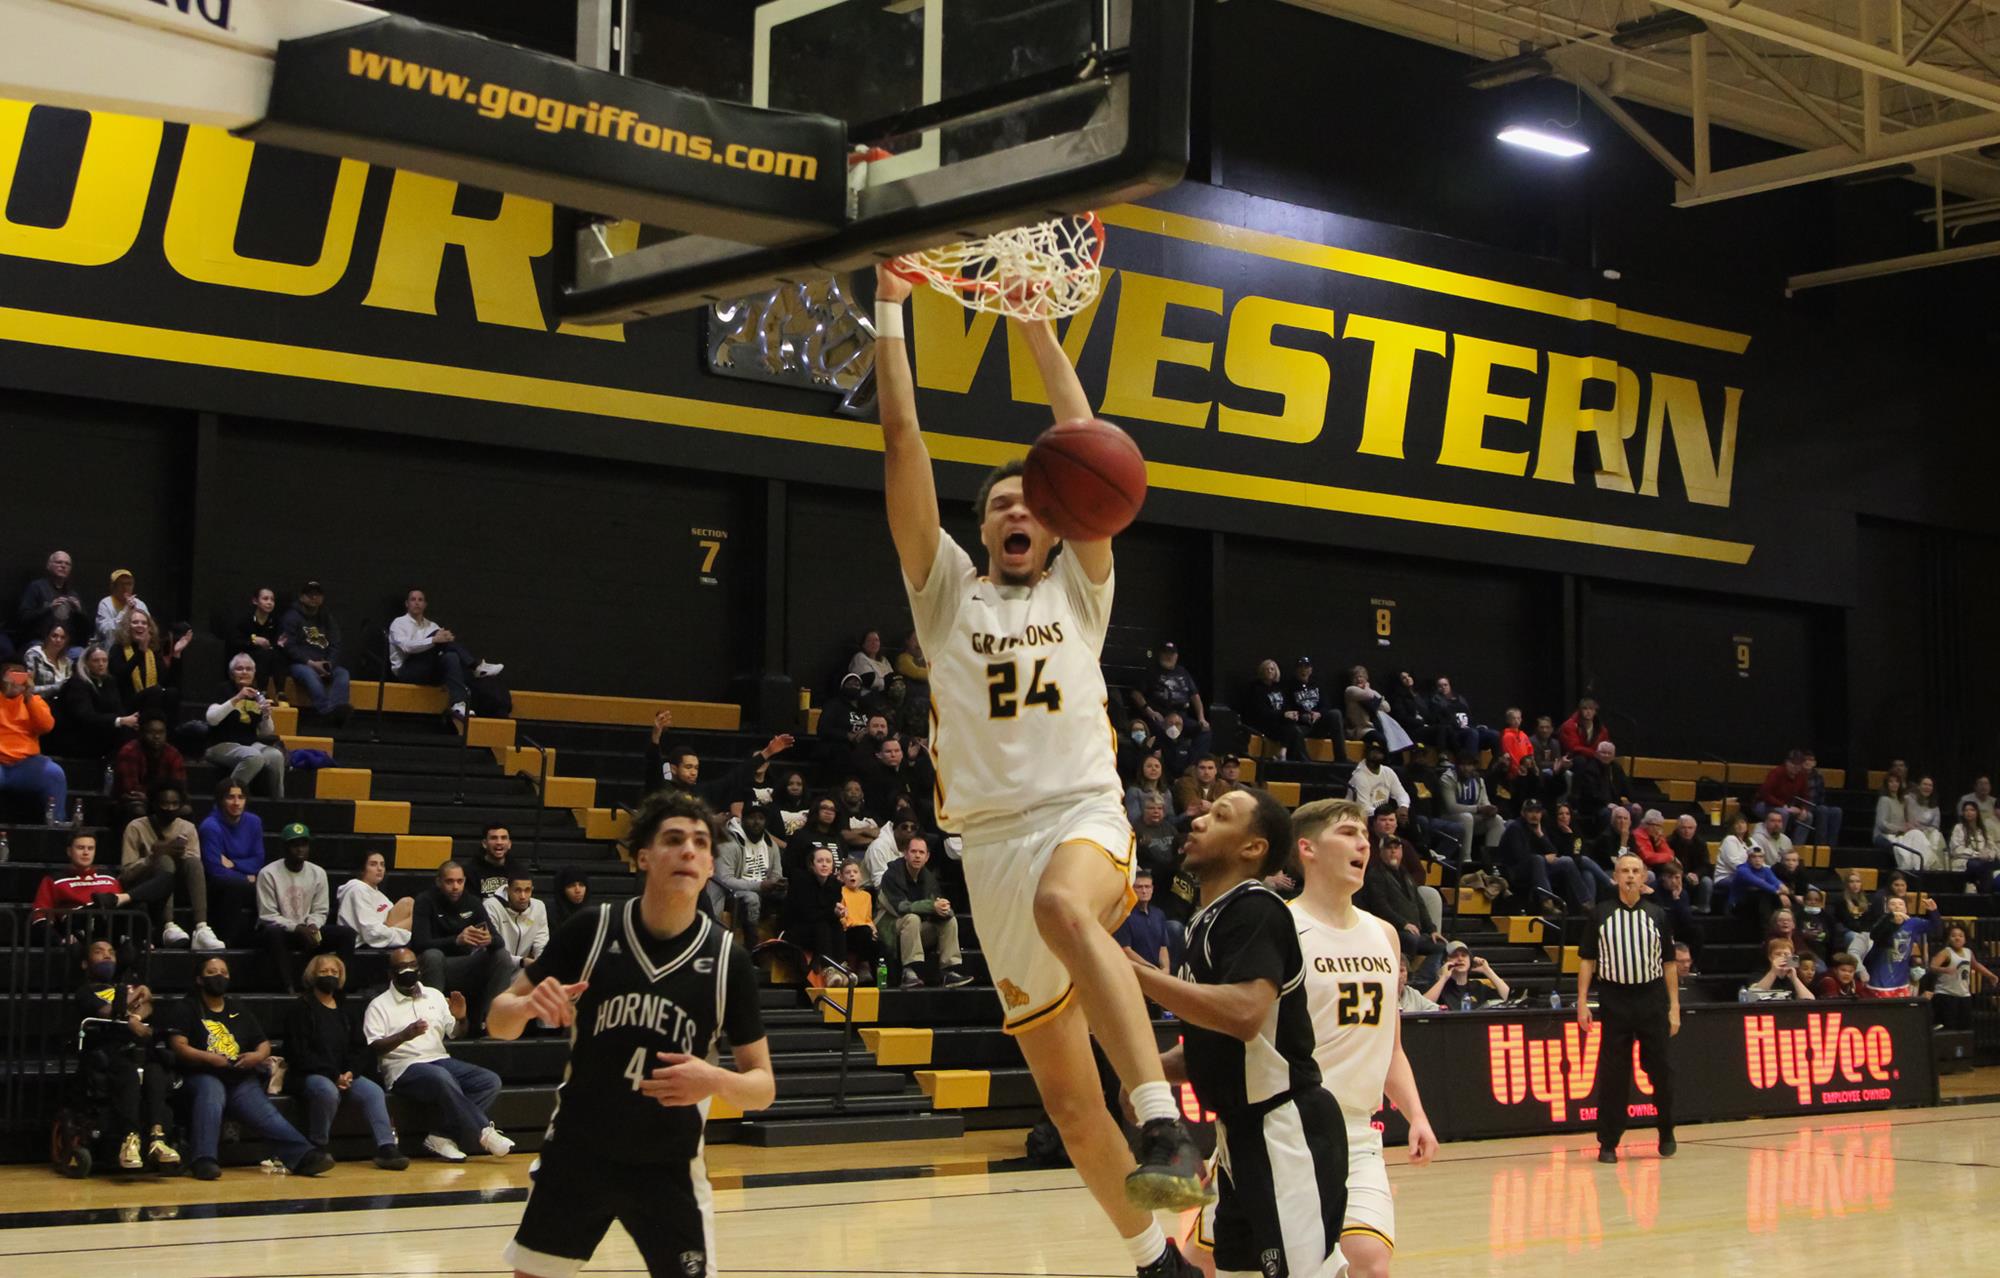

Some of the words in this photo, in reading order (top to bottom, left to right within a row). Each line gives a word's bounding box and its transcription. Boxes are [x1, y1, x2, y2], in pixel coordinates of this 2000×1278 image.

[347, 47, 818, 182] www.gogriffons.com
[911, 242, 1744, 508] WESTERN
[691, 527, 729, 539] SECTION
[699, 540, 721, 573] 7
[972, 621, 1064, 655] GRIONS
[1376, 608, 1392, 636] 8
[1737, 644, 1750, 669] 9
[986, 656, 1064, 721] 24
[1314, 956, 1392, 974] GRIFFONS
[1337, 981, 1384, 1027] 23
[592, 992, 697, 1056] HORNETS
[623, 1045, 648, 1092] 4
[1822, 1090, 1861, 1104] EMPLOYEE
[1862, 1087, 1891, 1101] OWNED
